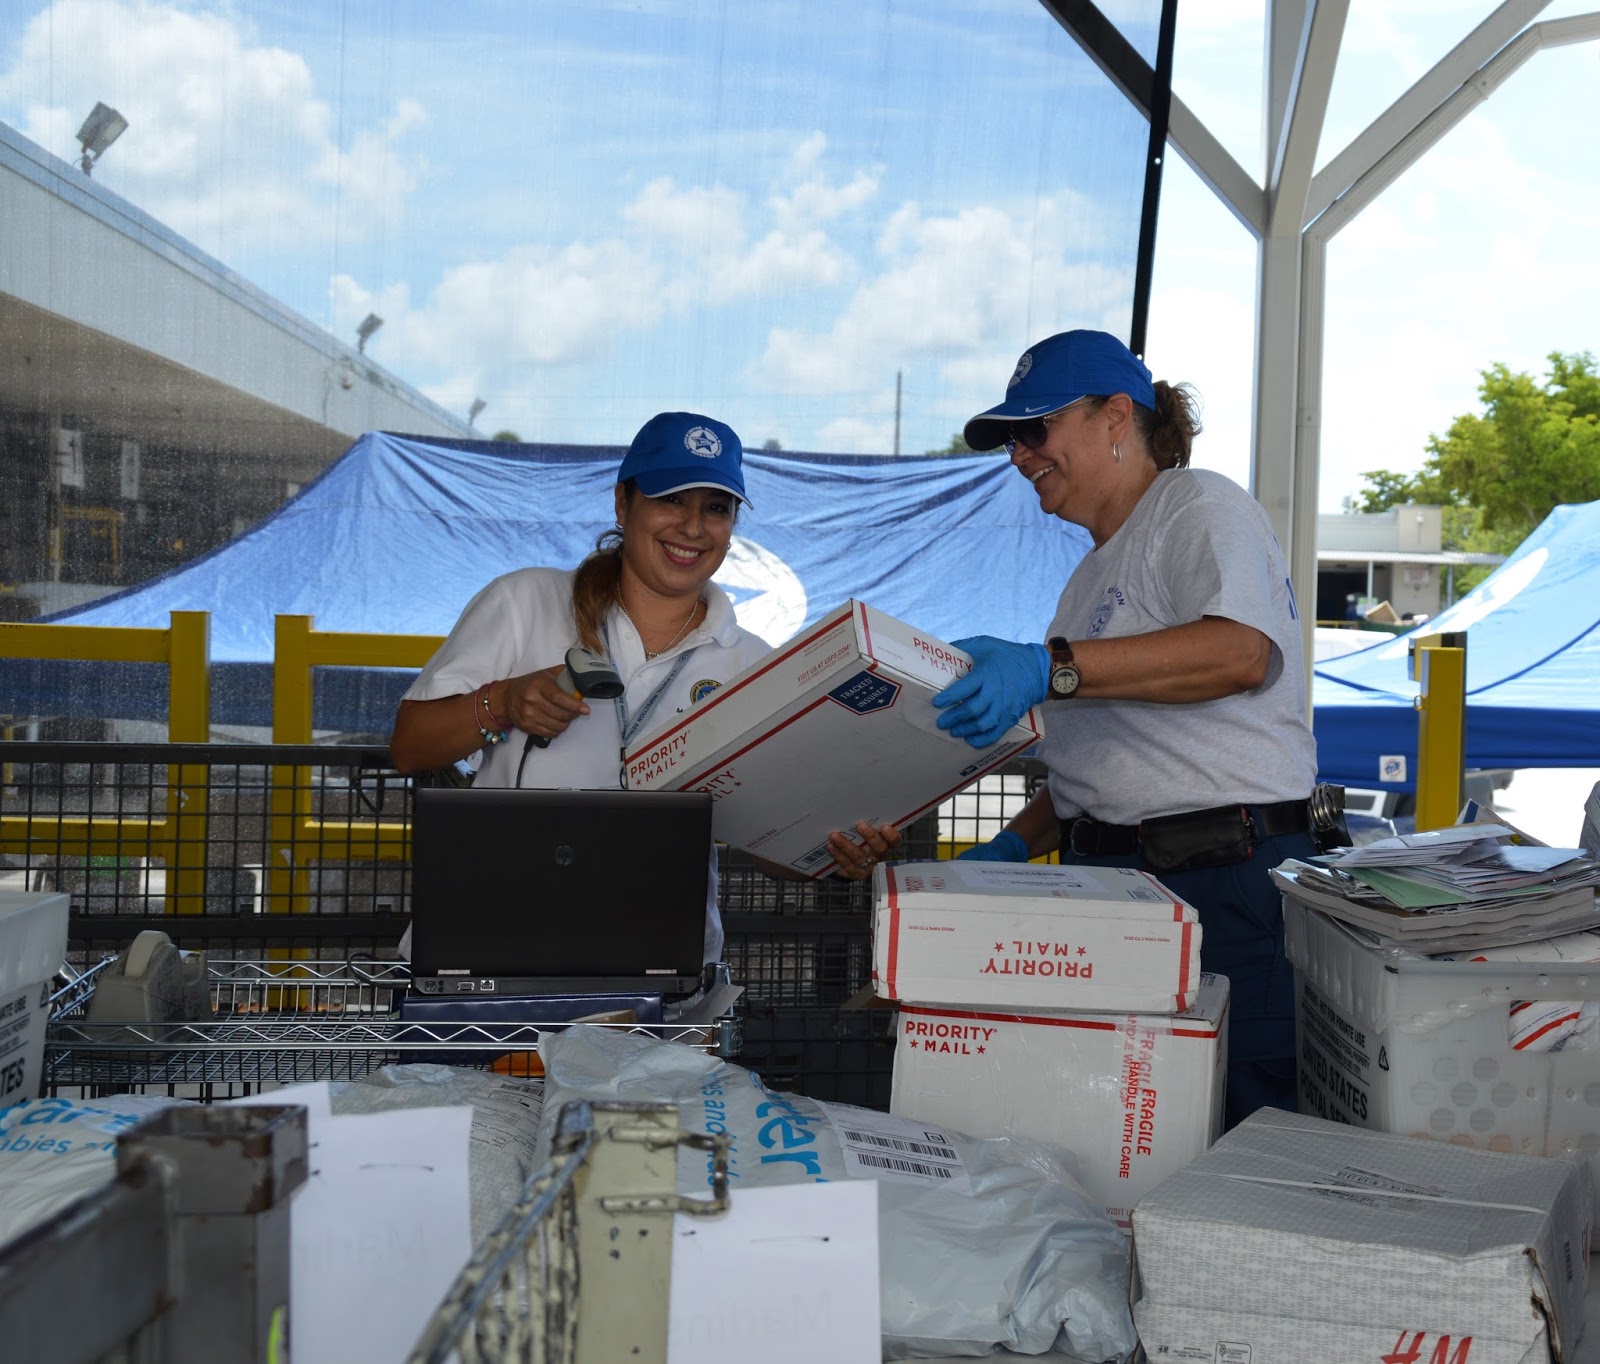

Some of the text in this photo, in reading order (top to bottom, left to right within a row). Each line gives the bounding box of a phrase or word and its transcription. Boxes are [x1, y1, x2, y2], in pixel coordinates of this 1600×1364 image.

[913, 636, 972, 673] PRIORITY
[796, 669, 810, 682] VISIT
[809, 664, 818, 673] US
[816, 660, 824, 669] AT
[930, 656, 962, 679] MAIL
[840, 677, 873, 699] TRACKED
[857, 685, 888, 708] INSURED
[638, 694, 660, 723] INSPECTION
[629, 730, 688, 779] PRIORITY
[645, 758, 677, 783] MAIL
[696, 769, 736, 793] RITY
[1012, 940, 1069, 957] MAIL
[984, 957, 1093, 979] PRIORITY
[905, 1020, 992, 1041] PRIORITY
[1124, 1013, 1137, 1050] ANDLE
[1354, 1027, 1366, 1048] USE
[924, 1039, 971, 1055] MAIL
[1302, 1035, 1328, 1083] UNITED
[1329, 1065, 1368, 1121] STATES
[1301, 1069, 1328, 1120] POSTAL
[1119, 1060, 1140, 1179] HANDLE WITH CARE
[1137, 1087, 1157, 1156] FRAGILE
[1105, 1206, 1125, 1216] VISIT
